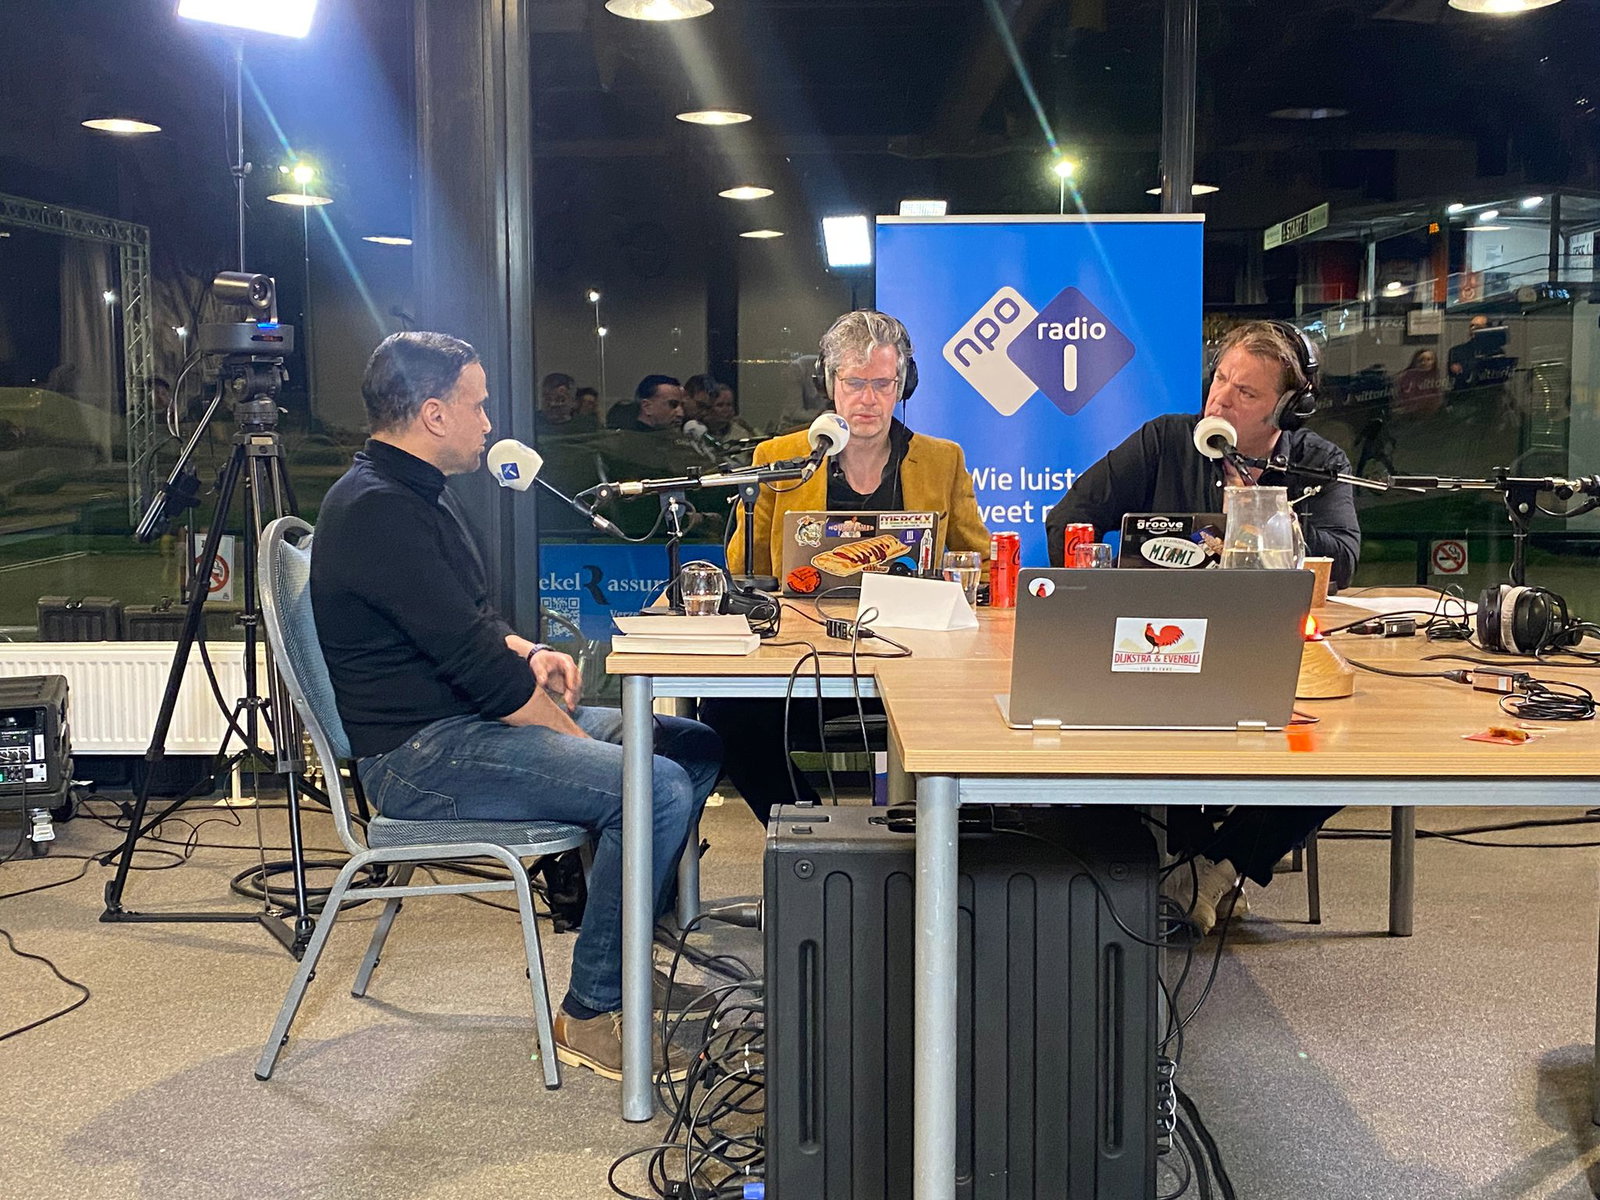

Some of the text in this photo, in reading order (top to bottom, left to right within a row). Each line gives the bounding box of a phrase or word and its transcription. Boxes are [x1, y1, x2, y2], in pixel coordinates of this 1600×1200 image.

[953, 297, 1021, 368] npo
[1037, 316, 1107, 341] radio
[1063, 343, 1078, 393] 1
[1020, 466, 1083, 491] luist
[1137, 520, 1184, 530] groove
[1148, 544, 1196, 566] MIAMI
[1114, 653, 1152, 663] DIJKSTRA
[1154, 654, 1161, 663] &
